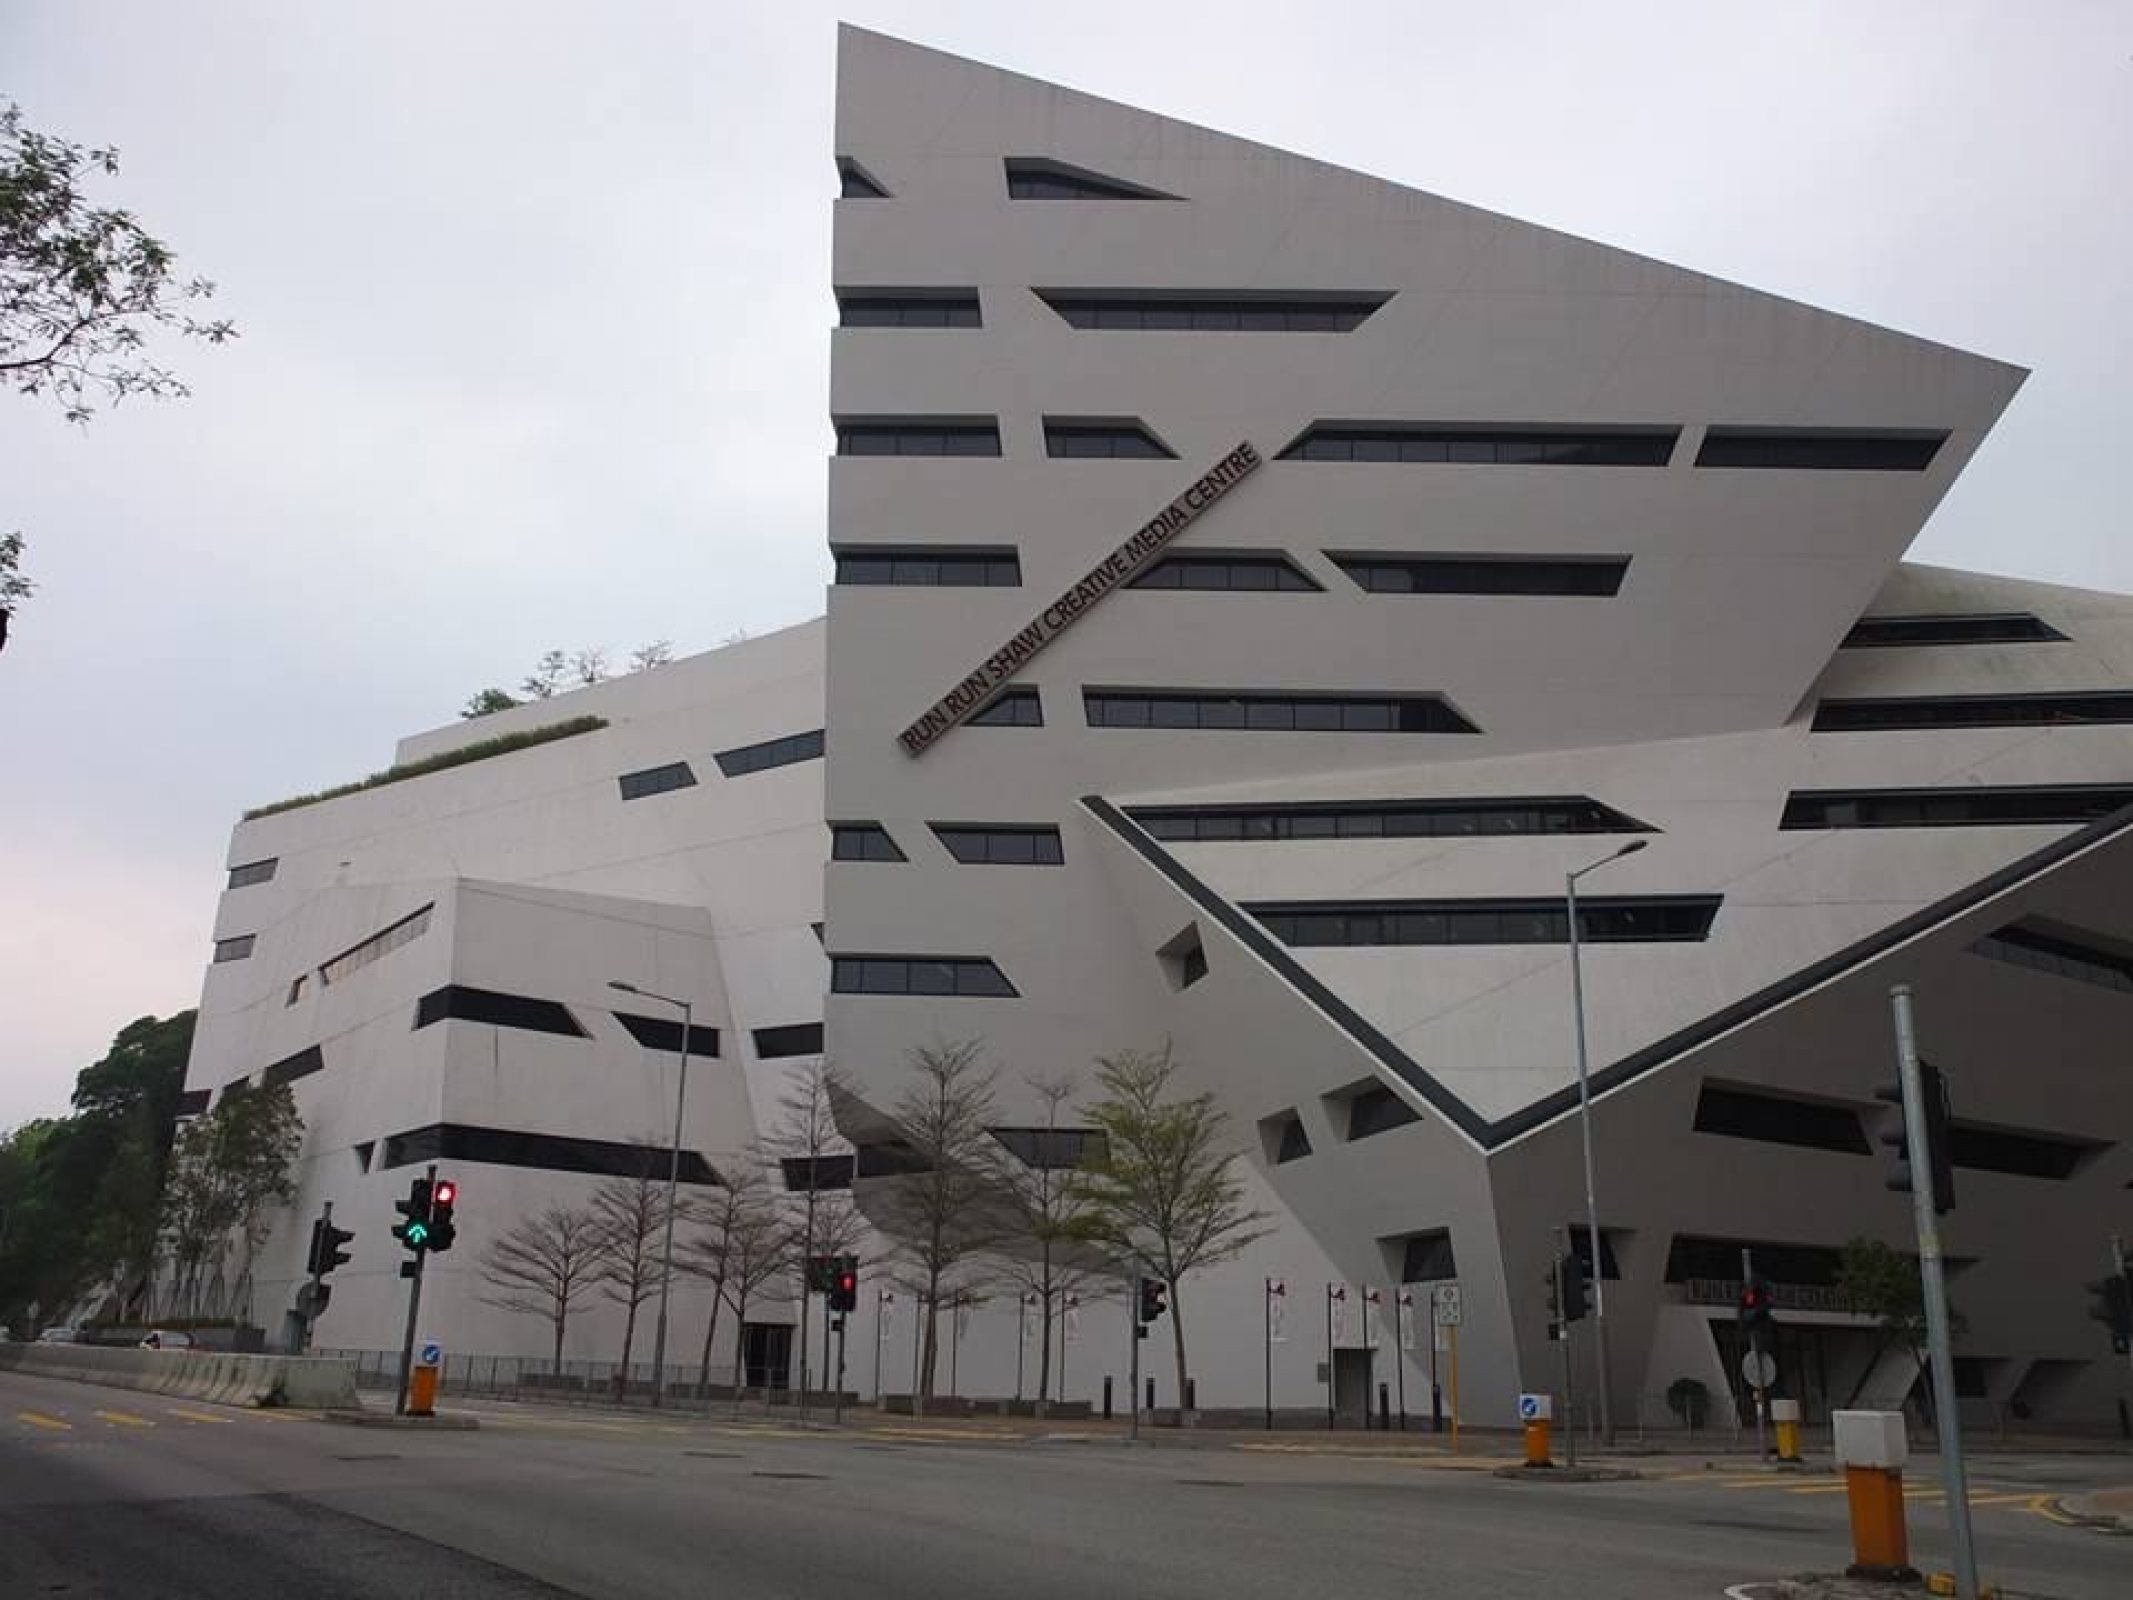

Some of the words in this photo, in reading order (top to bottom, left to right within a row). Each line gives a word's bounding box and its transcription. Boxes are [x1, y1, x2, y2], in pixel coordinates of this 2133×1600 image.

[903, 709, 948, 751] RUN
[945, 672, 990, 715] RUN
[987, 620, 1044, 679] SHAW
[1043, 552, 1128, 630] CREATIVE
[1126, 505, 1188, 562] MEDIA
[1184, 442, 1258, 510] CENTRE
